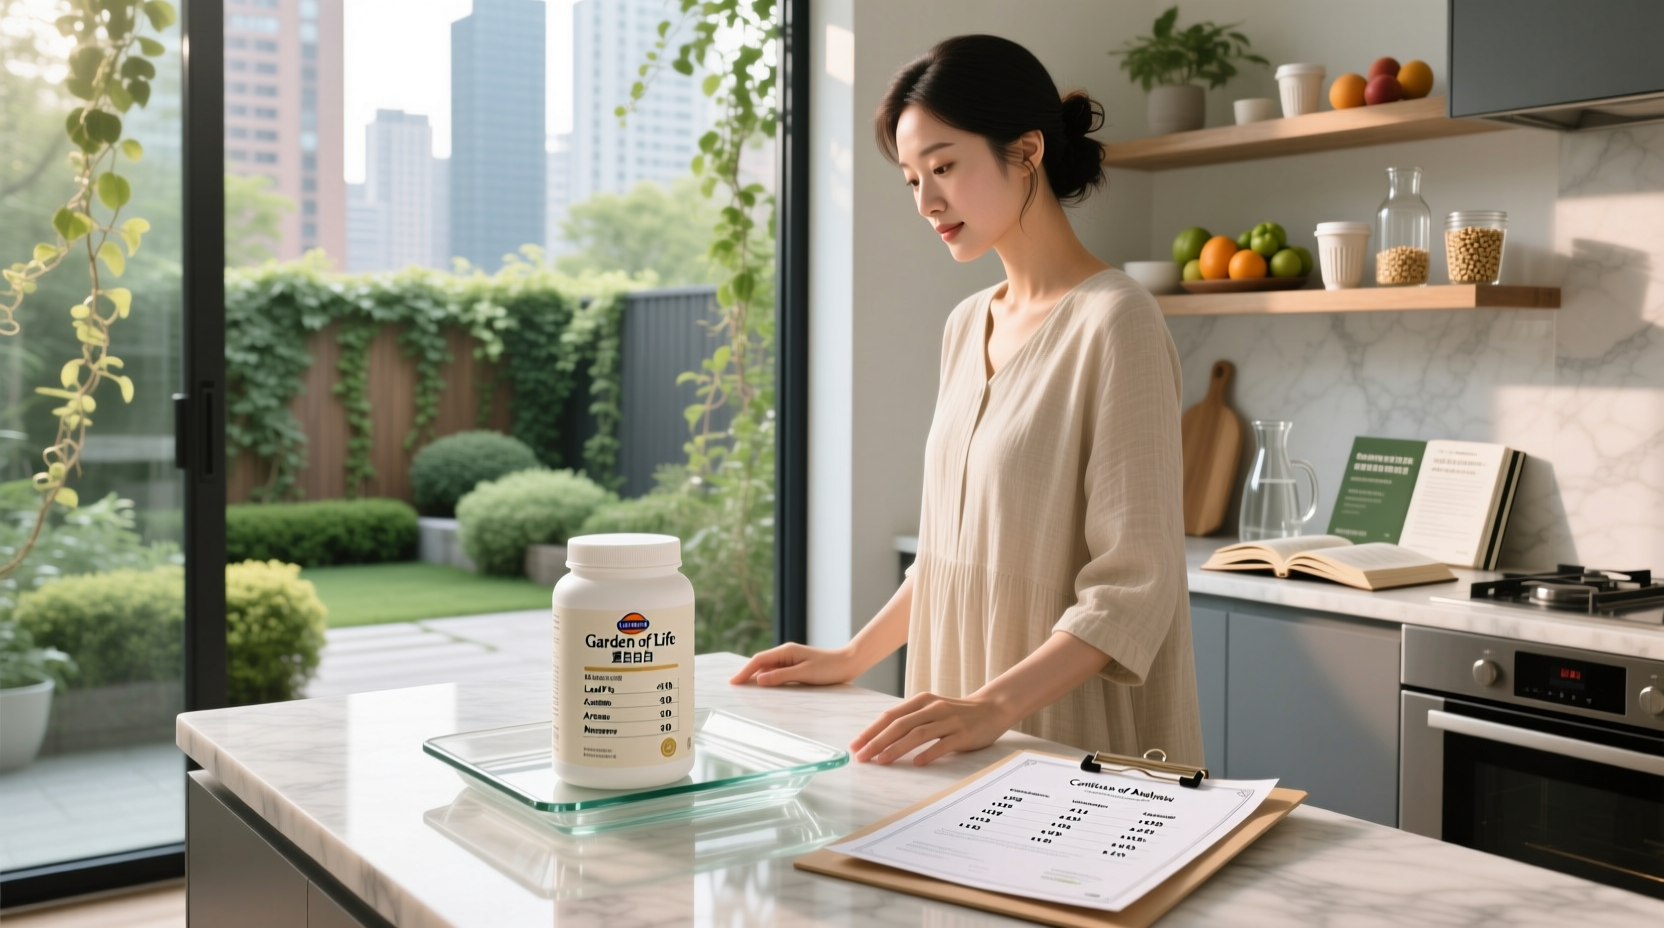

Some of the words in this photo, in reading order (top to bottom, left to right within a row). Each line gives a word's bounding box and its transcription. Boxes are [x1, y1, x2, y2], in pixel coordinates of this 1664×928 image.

[585, 634, 635, 648] Garden
[638, 633, 652, 649] of
[653, 631, 676, 647] Life
